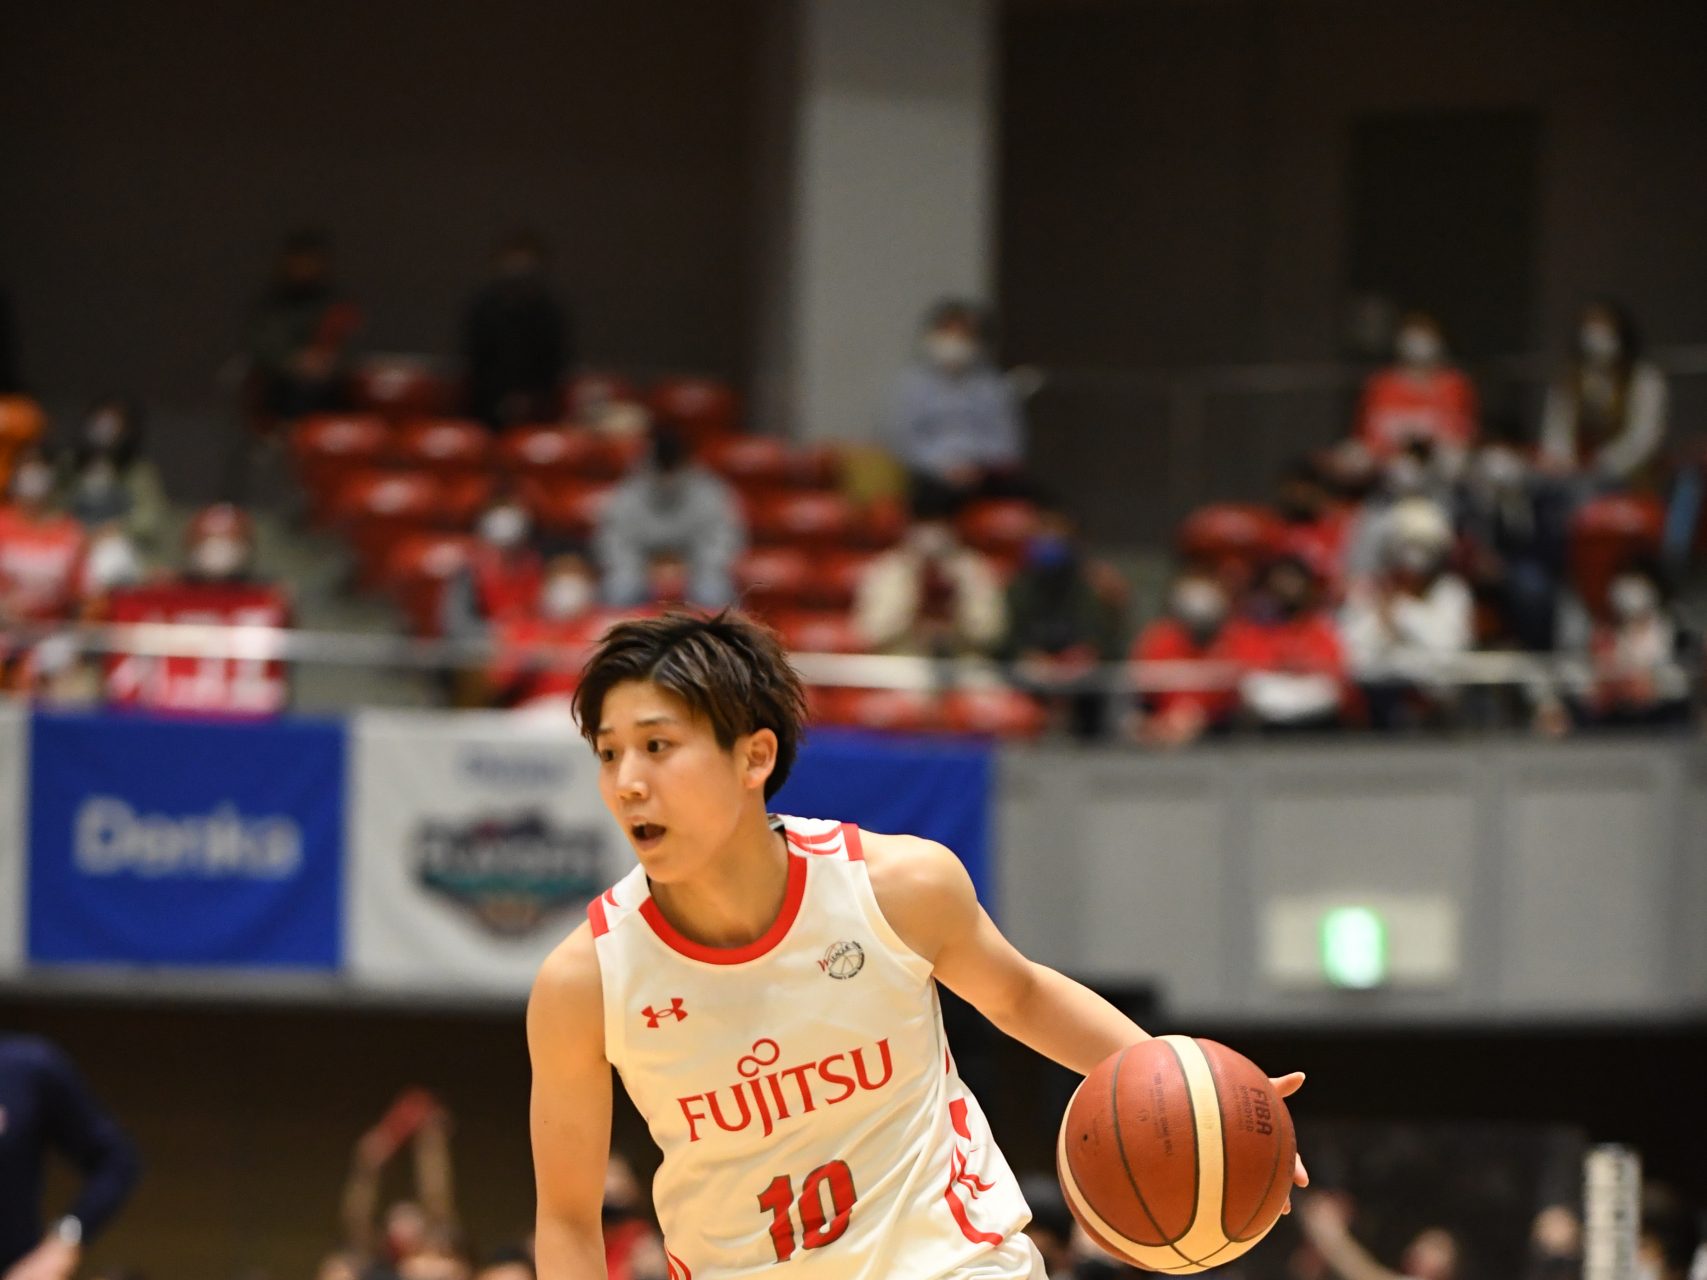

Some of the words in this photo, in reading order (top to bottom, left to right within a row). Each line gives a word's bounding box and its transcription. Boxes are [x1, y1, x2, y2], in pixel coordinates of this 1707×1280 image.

[76, 795, 302, 877] Denka
[677, 1037, 893, 1142] FUJITSU
[1250, 1087, 1273, 1136] FIBA
[757, 1159, 857, 1263] 10
